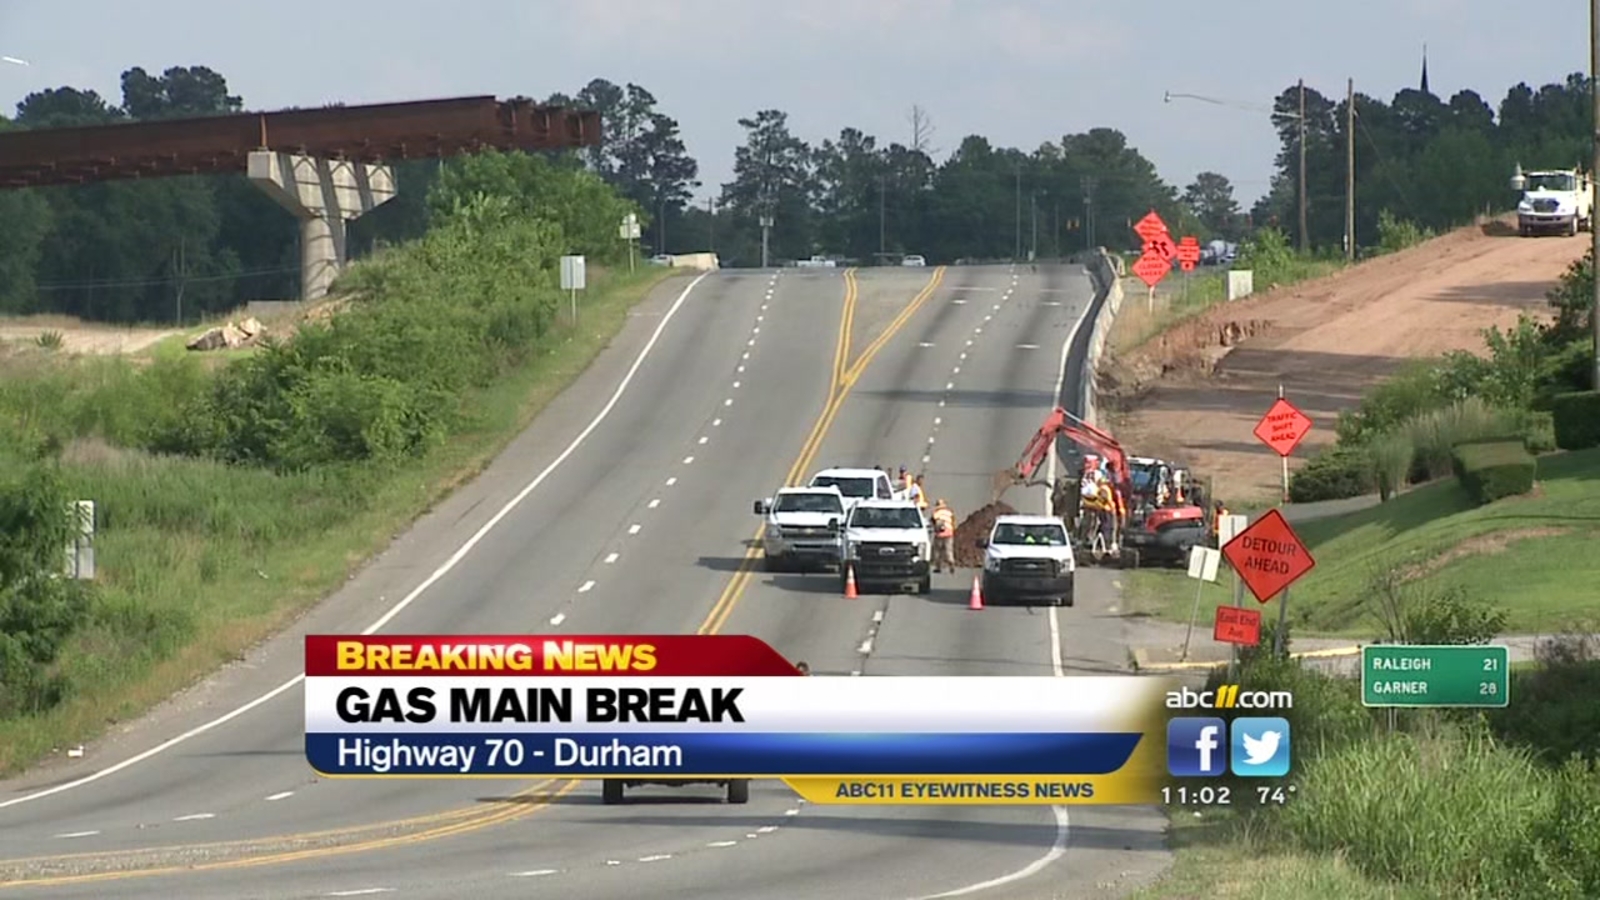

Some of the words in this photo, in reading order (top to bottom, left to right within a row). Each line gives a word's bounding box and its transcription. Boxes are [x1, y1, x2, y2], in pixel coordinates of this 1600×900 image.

[1267, 412, 1298, 423] TRAFFIC
[1272, 422, 1293, 432] SHIFT
[1271, 432, 1296, 442] AHEAD
[1241, 536, 1297, 556] DETOUR
[1245, 556, 1290, 575] AHEAD
[1373, 658, 1431, 670] RALEIGH
[1483, 658, 1498, 671] 21
[1373, 681, 1428, 694] GARNER
[1479, 682, 1498, 695] 28
